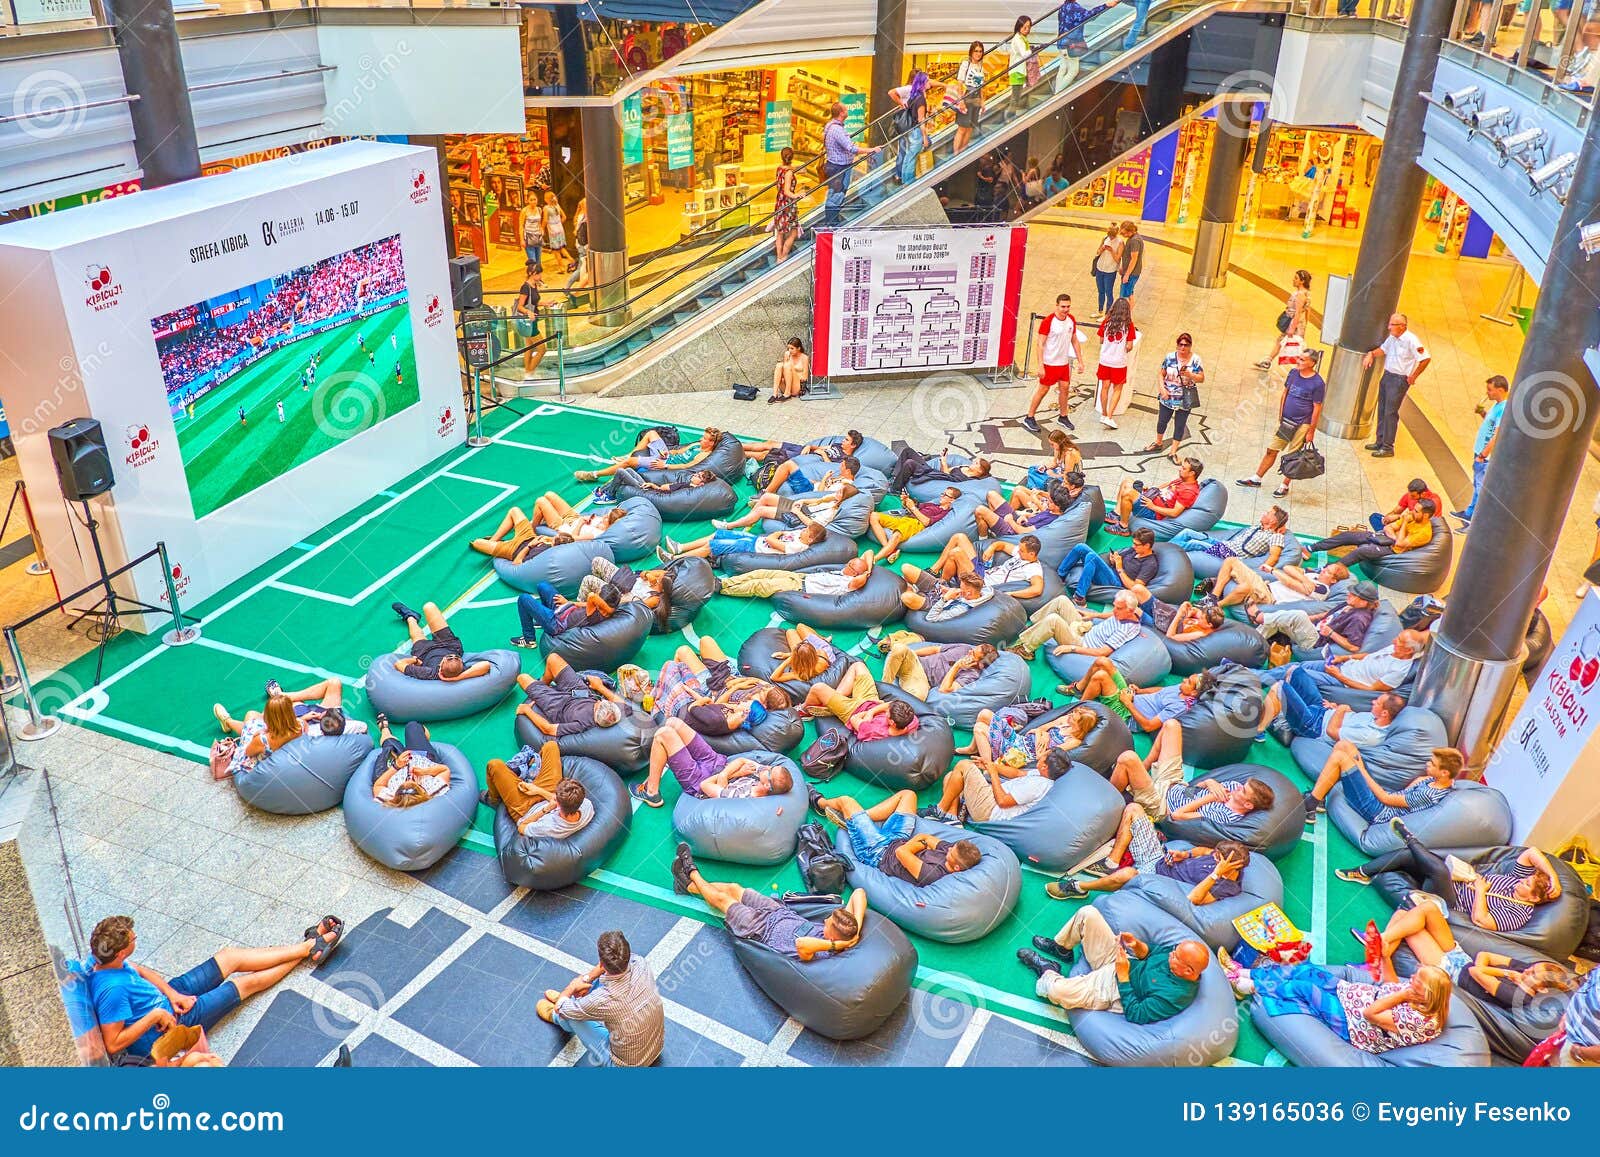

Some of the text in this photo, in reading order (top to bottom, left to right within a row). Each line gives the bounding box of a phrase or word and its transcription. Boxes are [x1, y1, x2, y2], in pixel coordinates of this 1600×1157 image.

[279, 216, 304, 232] GALERIA
[315, 207, 335, 225] 14.06
[341, 200, 359, 218] 15.07
[190, 233, 249, 264] STREFA KIBICA
[86, 284, 122, 306] KIBICUJ!
[126, 439, 159, 465] KIBICUJ!
[1548, 667, 1588, 733] KIBICUJ!
[1543, 695, 1567, 739] NASZYM
